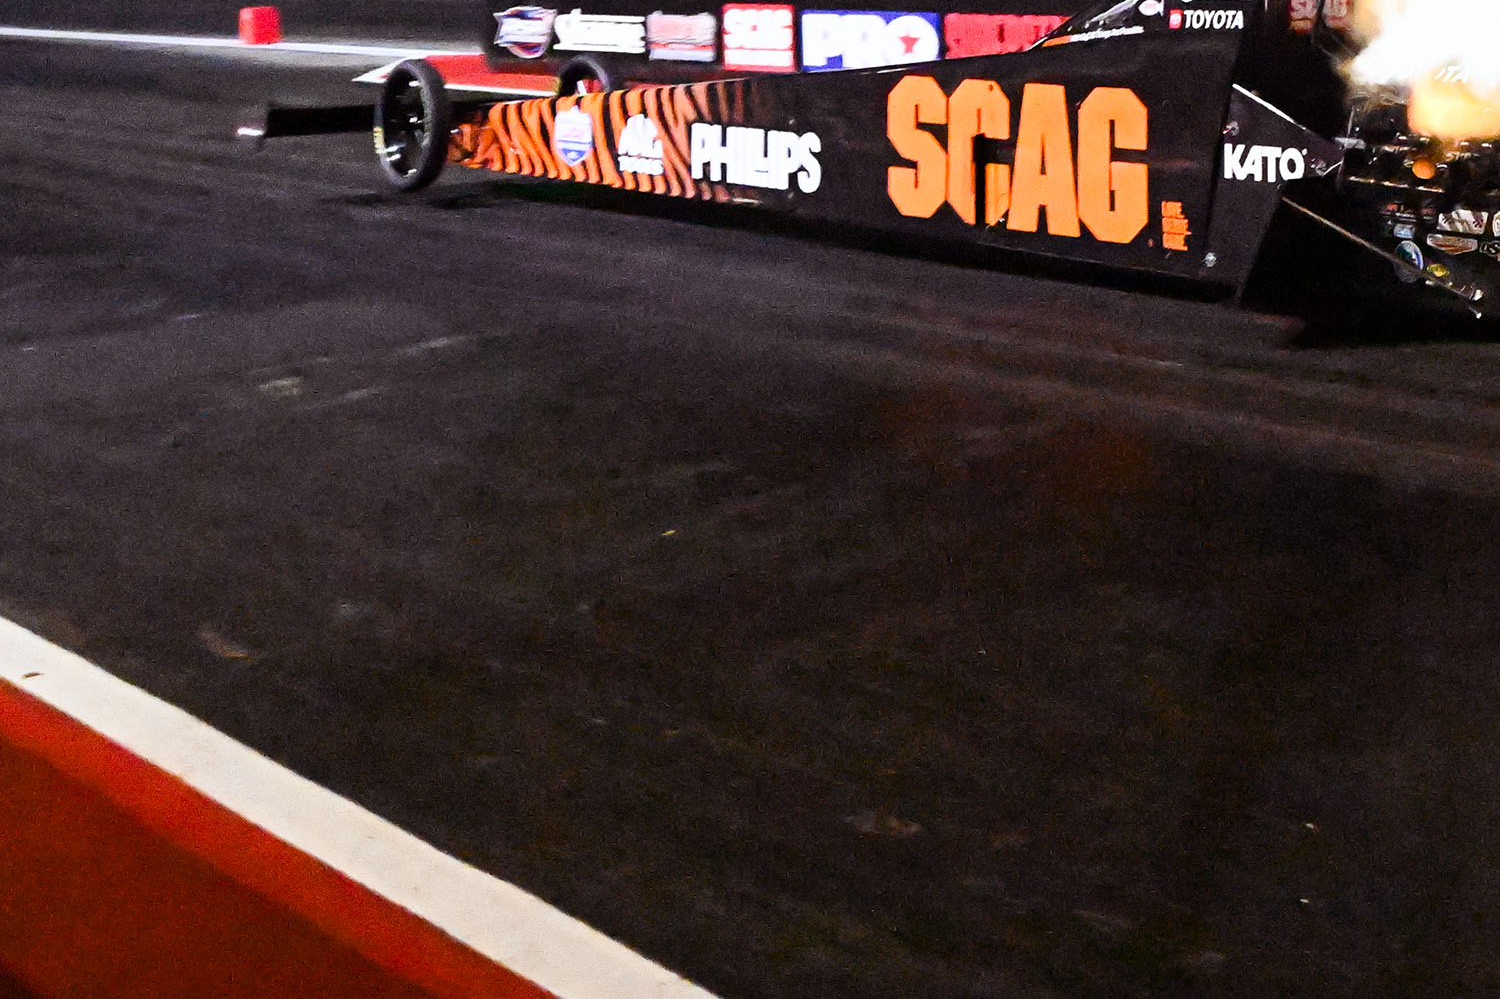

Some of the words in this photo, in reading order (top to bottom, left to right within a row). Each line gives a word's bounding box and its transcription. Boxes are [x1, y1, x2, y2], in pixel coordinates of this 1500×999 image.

[1184, 9, 1244, 29] TOYOTA
[887, 75, 1148, 244] SCAG
[1224, 143, 1306, 182] KATO
